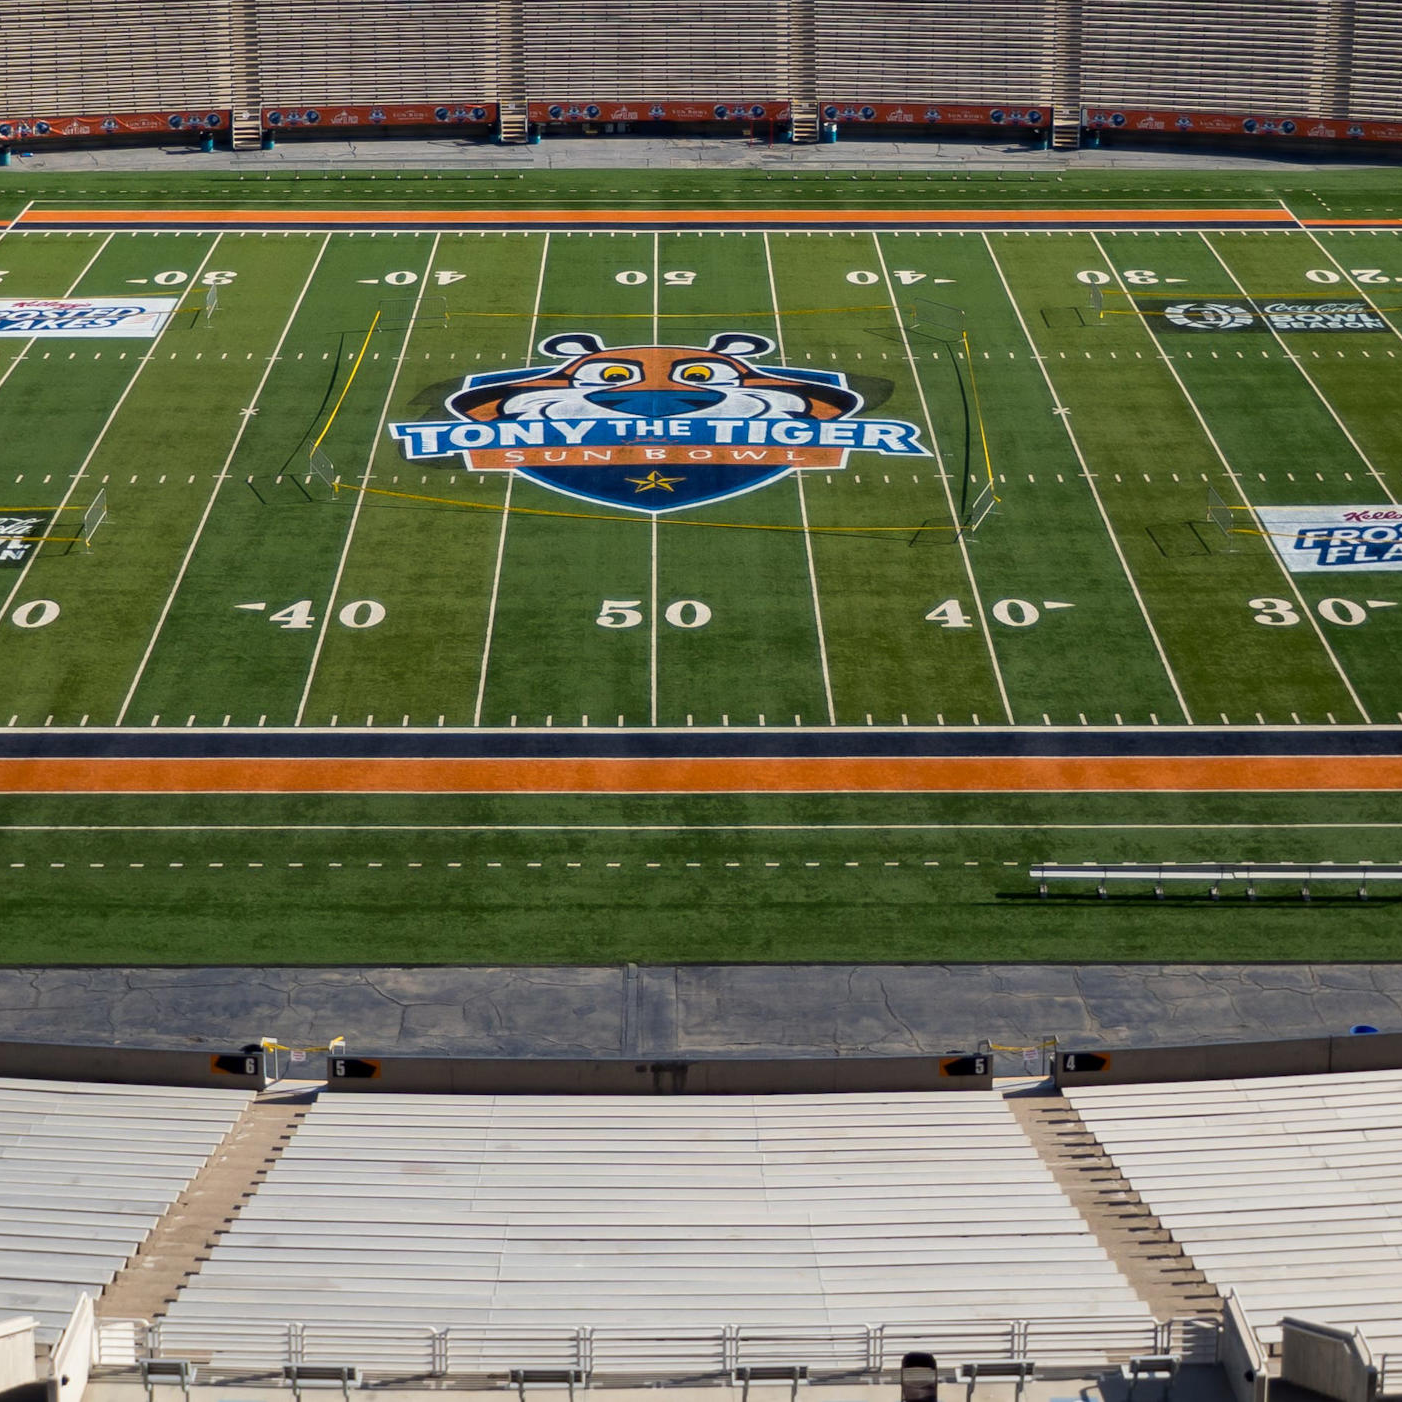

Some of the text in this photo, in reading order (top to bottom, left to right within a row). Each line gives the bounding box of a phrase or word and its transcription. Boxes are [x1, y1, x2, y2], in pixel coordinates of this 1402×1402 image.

[151, 269, 239, 286] 30
[383, 270, 467, 286] 40
[615, 270, 697, 286] 50
[846, 270, 928, 285] 40
[1076, 270, 1159, 285] 30
[1305, 269, 1393, 284] 20
[1269, 313, 1381, 323] BOWL
[404, 419, 908, 454] TONY THE TIGER
[503, 448, 807, 463] SUN BOWL
[268, 599, 388, 629] 40
[596, 599, 713, 629] 50
[924, 598, 1041, 628] 40
[1248, 597, 1368, 627] 30
[245, 1058, 255, 1074] 6
[335, 1060, 345, 1076] 5
[975, 1058, 985, 1074] 5
[1066, 1054, 1076, 1070] 4
